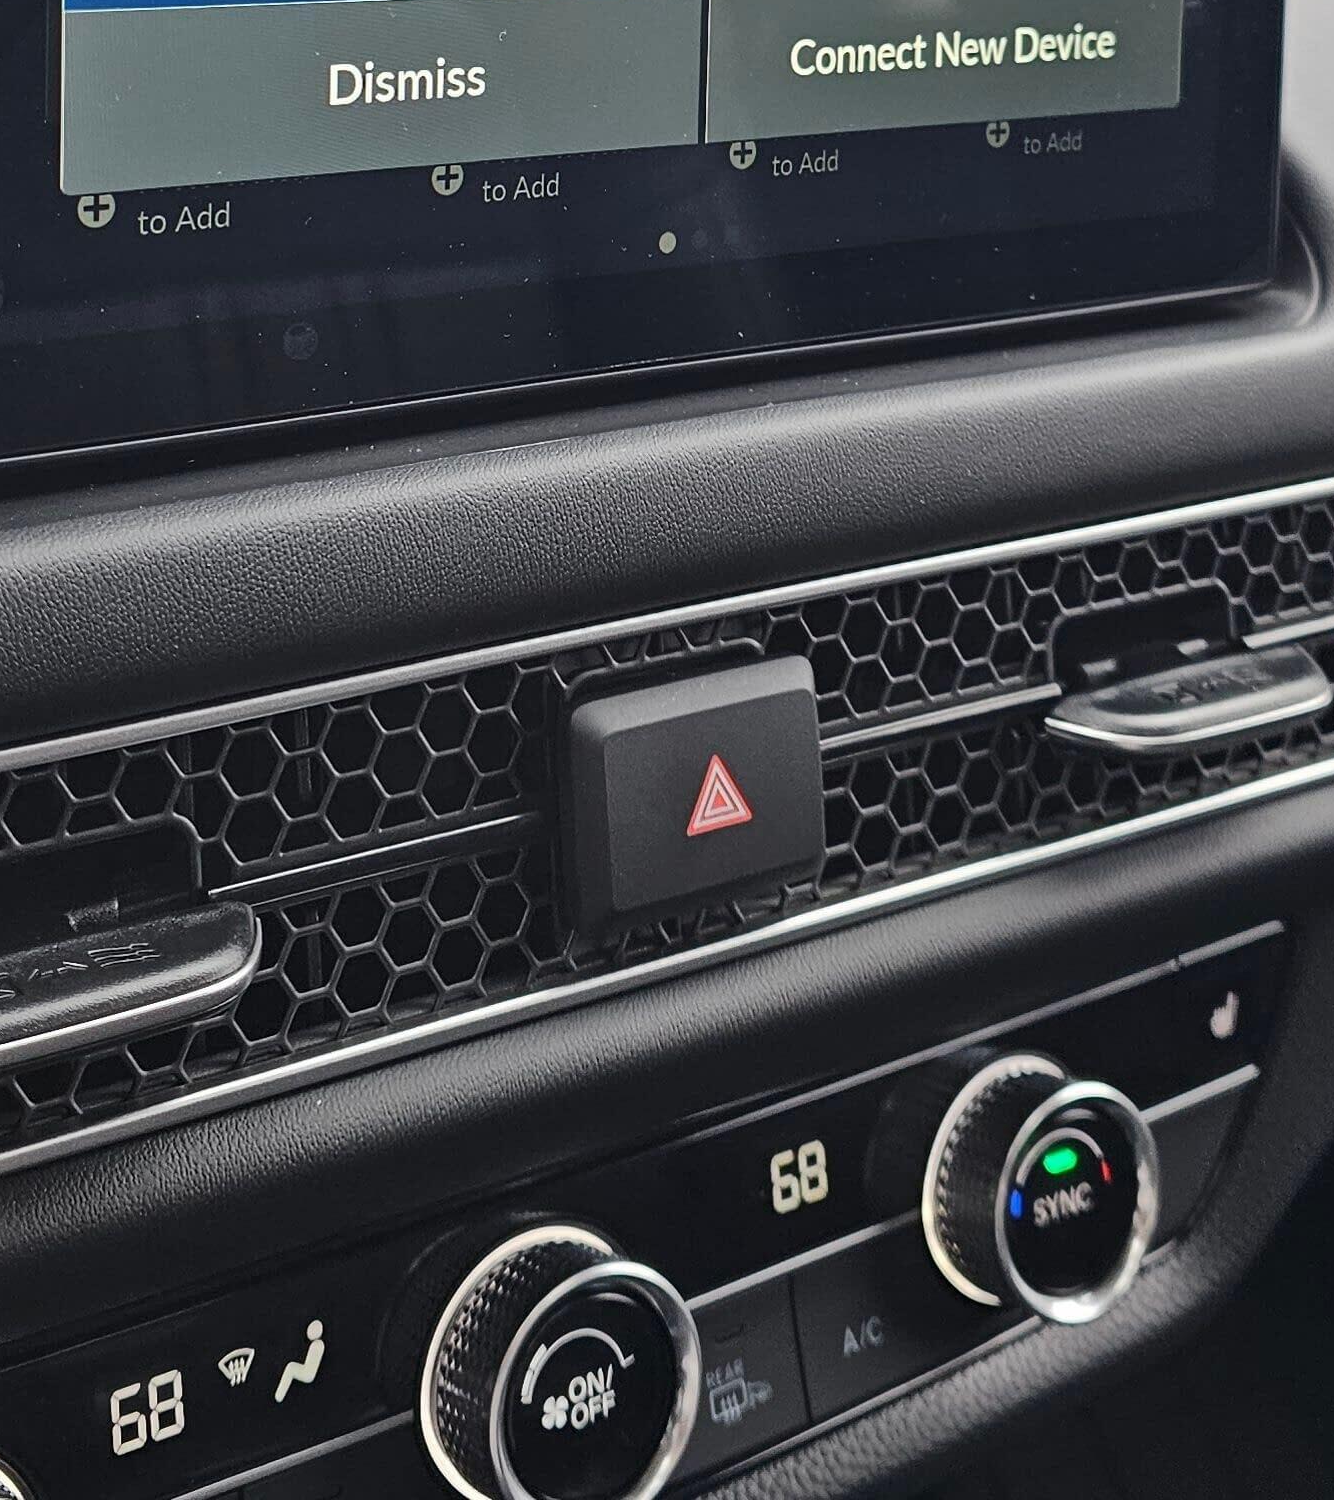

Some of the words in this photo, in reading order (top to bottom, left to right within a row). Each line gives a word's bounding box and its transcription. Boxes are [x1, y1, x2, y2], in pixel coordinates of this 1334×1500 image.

[790, 34, 928, 76] Connect
[935, 30, 1008, 68] New
[1014, 22, 1116, 64] Device
[329, 56, 486, 106] Dismiss
[771, 155, 793, 177] to
[798, 148, 839, 175] Add
[1023, 136, 1042, 155] to
[1046, 131, 1083, 153] Add
[482, 180, 507, 203] to
[513, 171, 560, 201] Add
[137, 211, 167, 235] to
[174, 200, 230, 233] Add
[770, 1139, 829, 1214] 68
[1033, 1181, 1092, 1226] SYNC
[843, 1315, 884, 1358] A/C
[110, 1369, 185, 1456] 68
[569, 1389, 618, 1431] OFF
